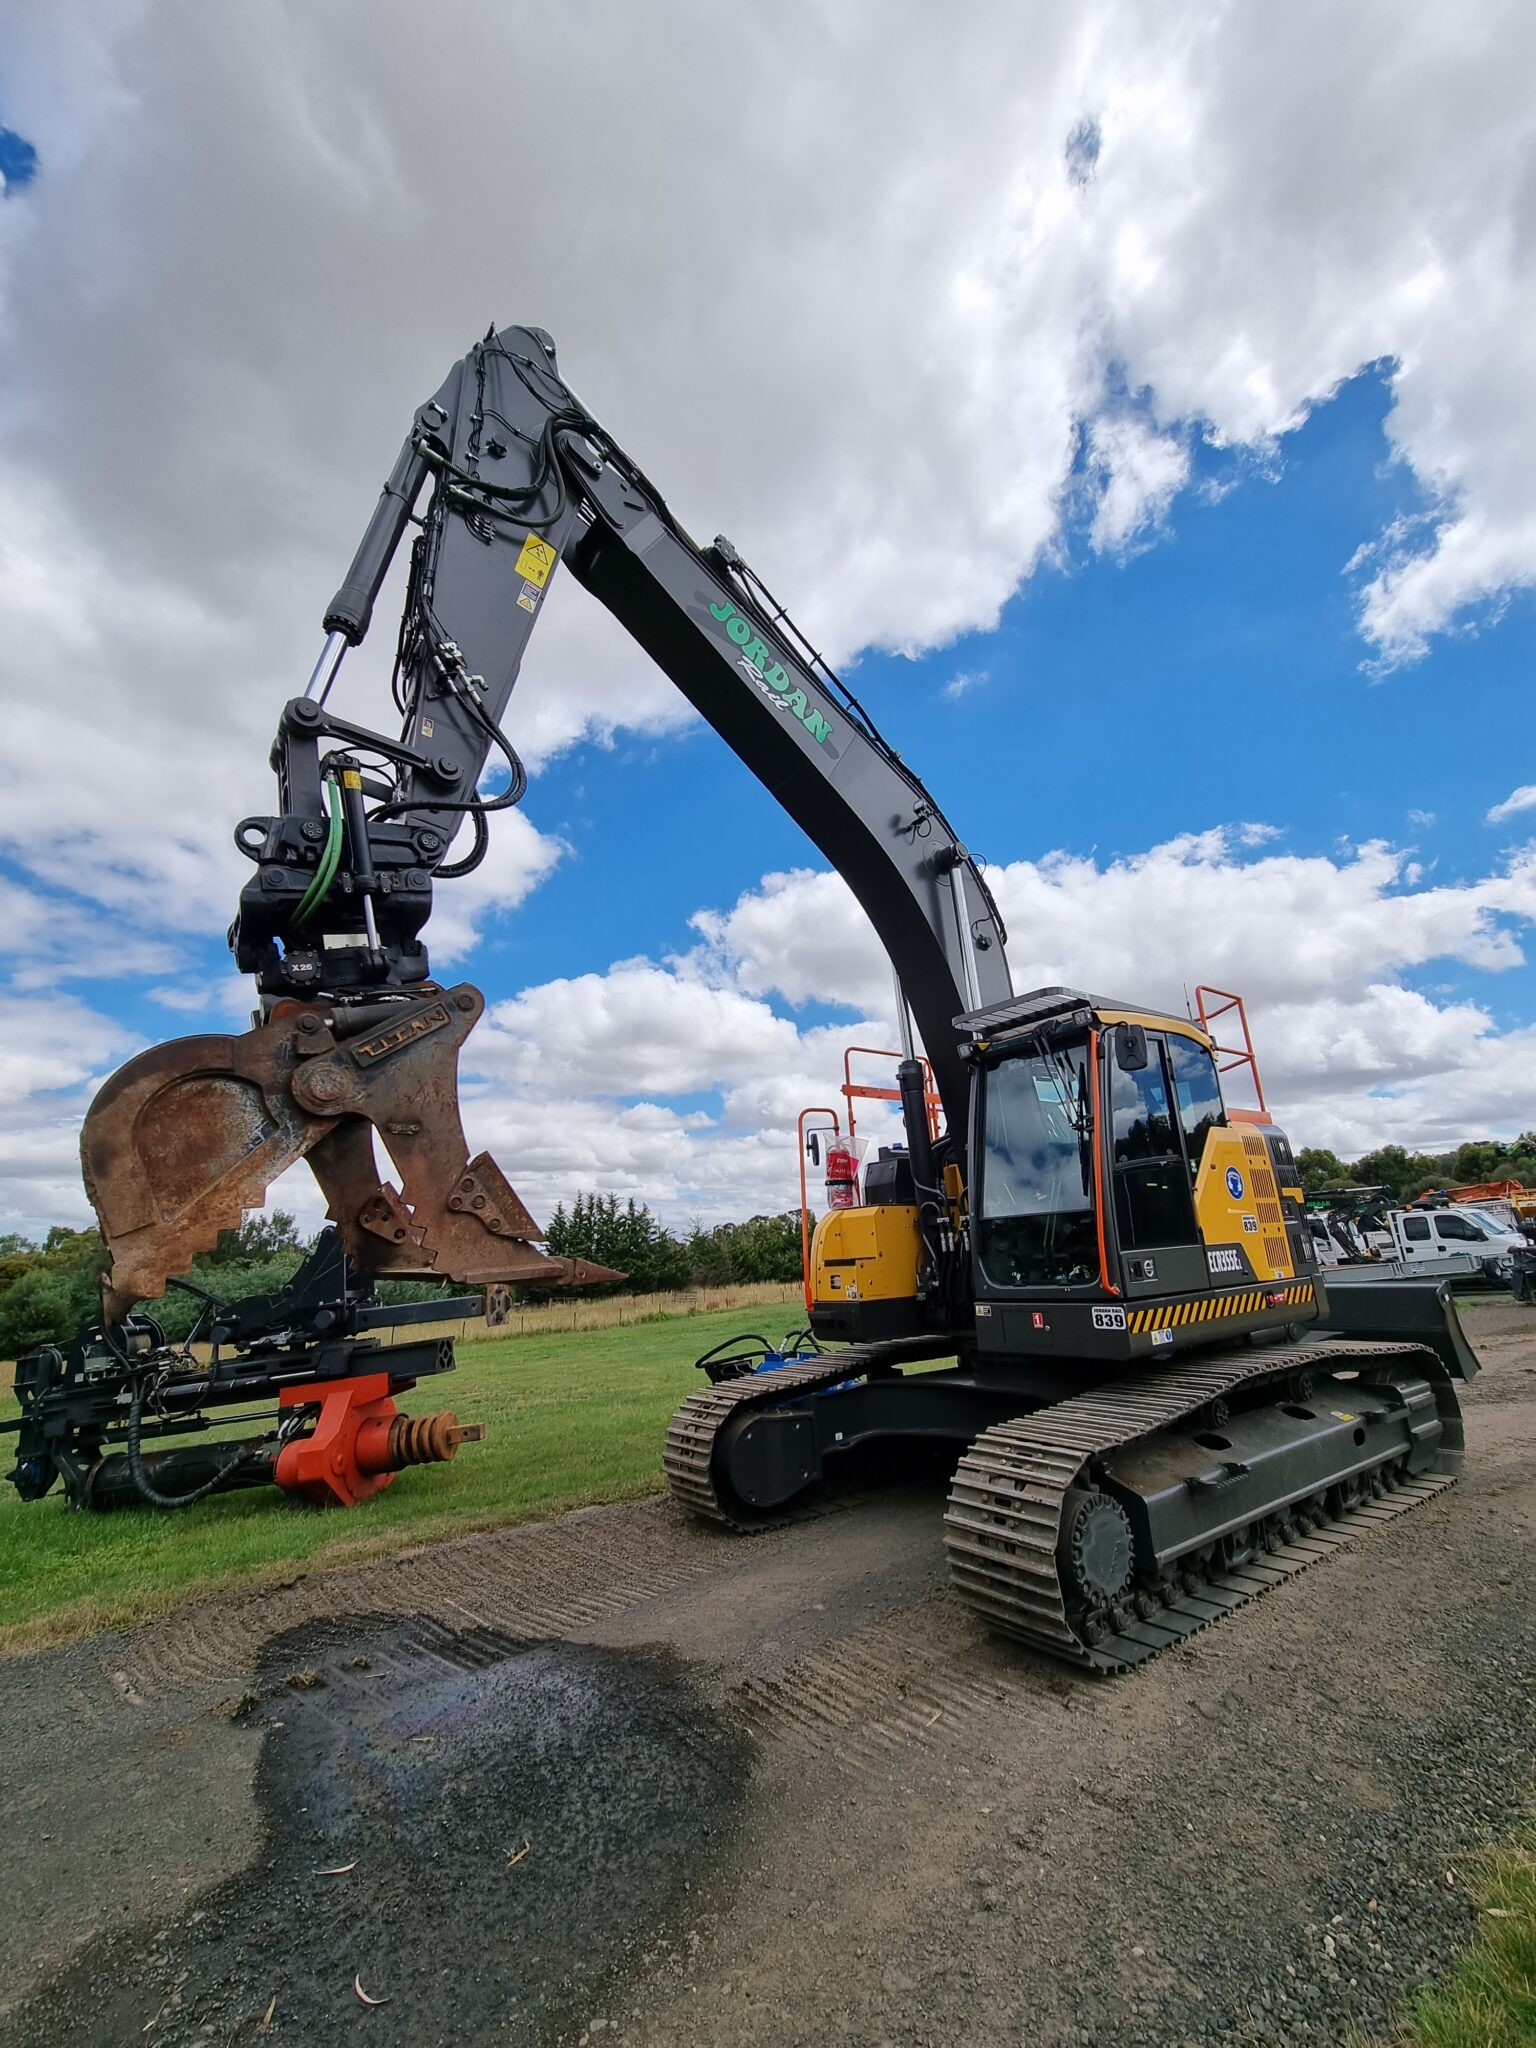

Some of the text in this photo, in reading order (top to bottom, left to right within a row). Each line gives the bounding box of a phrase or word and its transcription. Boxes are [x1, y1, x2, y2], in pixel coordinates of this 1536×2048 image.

[709, 601, 833, 744] JORDAN
[737, 655, 790, 712] Rail
[291, 963, 313, 972] X26
[358, 1009, 445, 1057] TITAN
[1243, 1220, 1257, 1231] 839
[1095, 1314, 1124, 1328] 839
